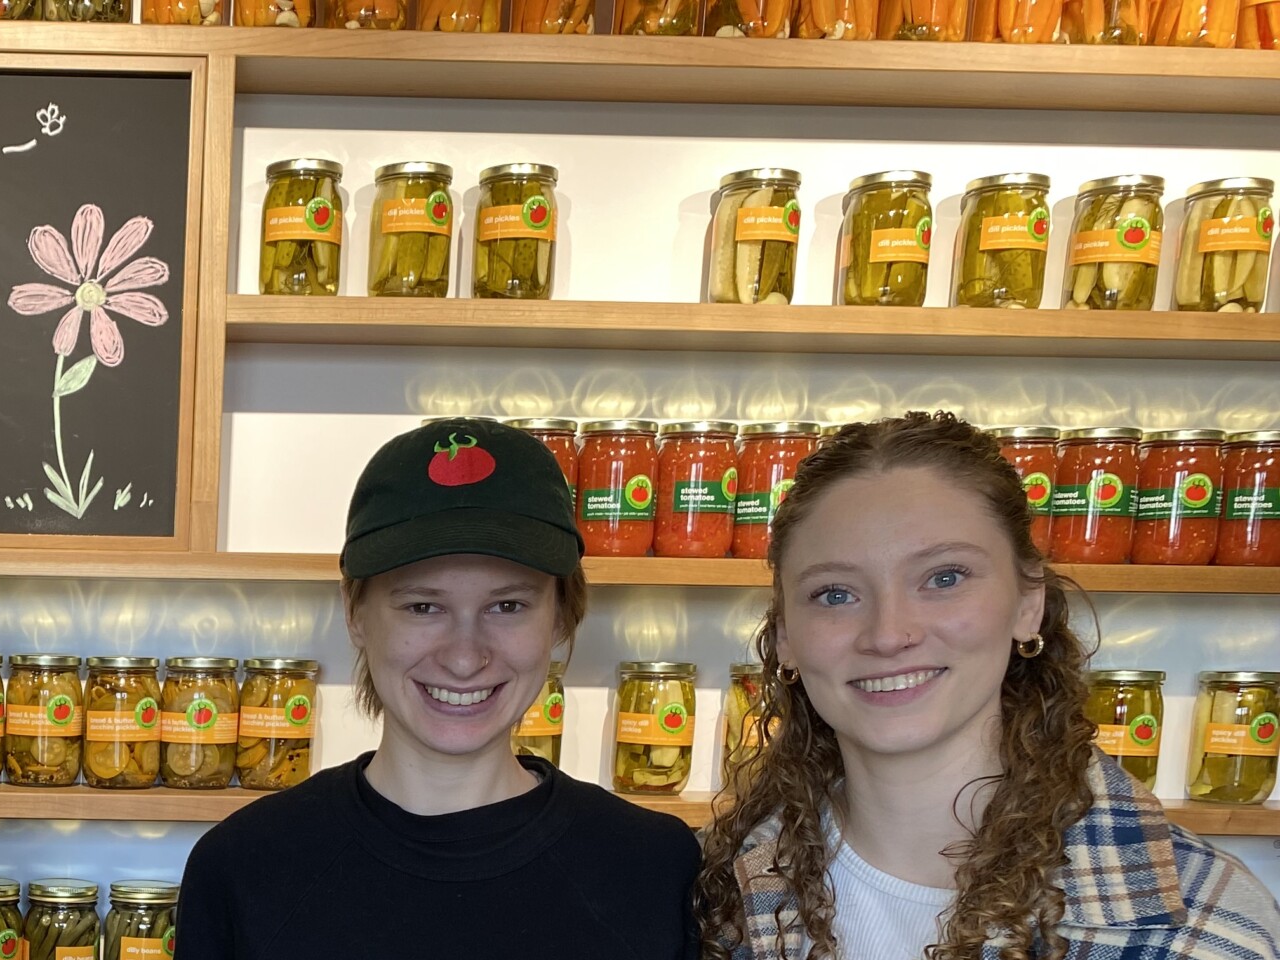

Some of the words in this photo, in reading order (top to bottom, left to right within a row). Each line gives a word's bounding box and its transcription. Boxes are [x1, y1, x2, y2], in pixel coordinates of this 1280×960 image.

[398, 208, 425, 217] pickles
[279, 216, 304, 226] pickles
[494, 215, 520, 224] pickles
[743, 216, 756, 224] dill
[756, 216, 783, 225] pickles
[988, 225, 1000, 233] dill
[1221, 227, 1250, 236] pickles
[878, 239, 890, 247] dill
[1082, 241, 1109, 251] pickles
[680, 486, 708, 495] stewed
[587, 494, 613, 503] stewed
[680, 493, 715, 502] tomatoes
[1139, 495, 1165, 503] stewed
[1234, 494, 1265, 503] stewed
[587, 502, 621, 510] tomatoes
[737, 499, 760, 507] stewed
[1138, 501, 1173, 510] tomatoes
[1233, 501, 1273, 510] tomatoes
[737, 506, 767, 514] tomatoes
[115, 724, 140, 732] pickles
[265, 720, 290, 728] pickles
[1212, 729, 1233, 738] spicy
[1210, 736, 1237, 744] pickles
[126, 946, 140, 955] dilly
[140, 946, 162, 955] beans
